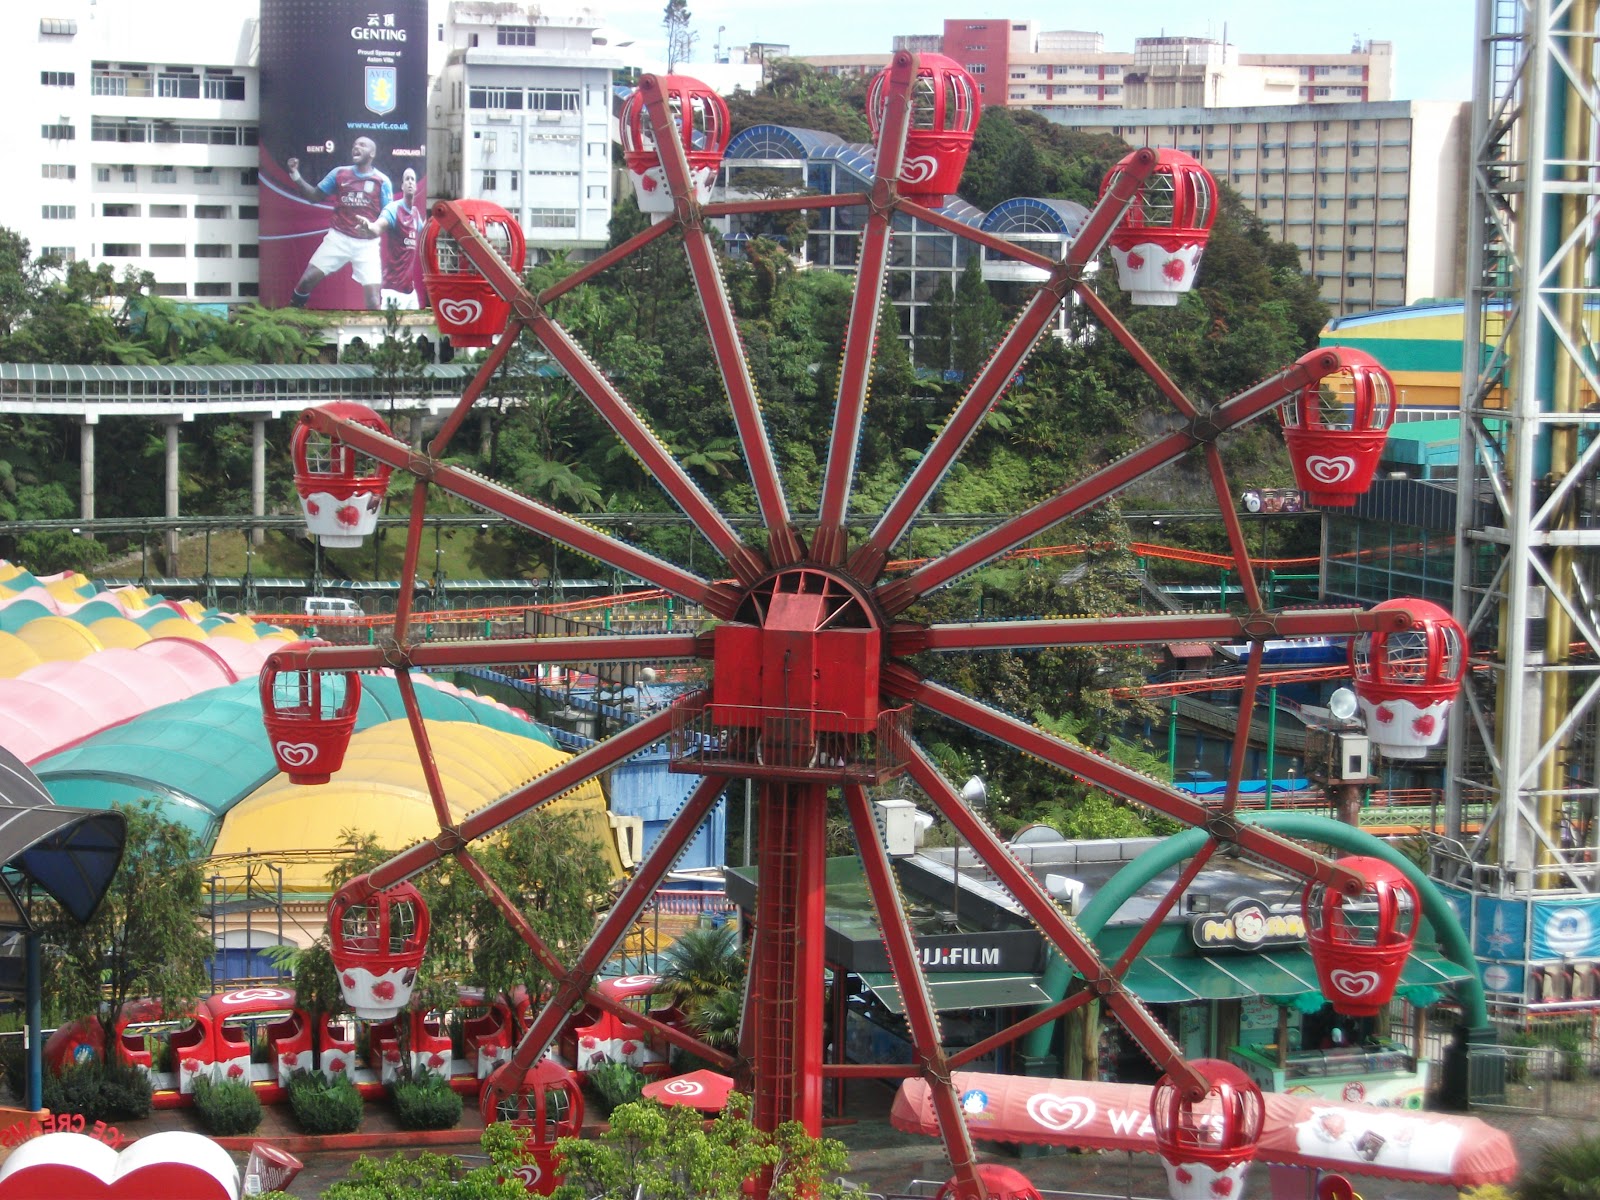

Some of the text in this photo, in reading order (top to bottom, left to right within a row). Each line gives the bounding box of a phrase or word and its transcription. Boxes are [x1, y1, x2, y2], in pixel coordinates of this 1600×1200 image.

[350, 26, 407, 42] GENTING
[357, 48, 374, 56] Proud
[375, 49, 395, 57] Sponsor
[369, 70, 393, 78] AVFC
[346, 122, 409, 130] www.avfc.co.uk
[325, 140, 335, 153] 9
[914, 947, 999, 965] UJIFILM
